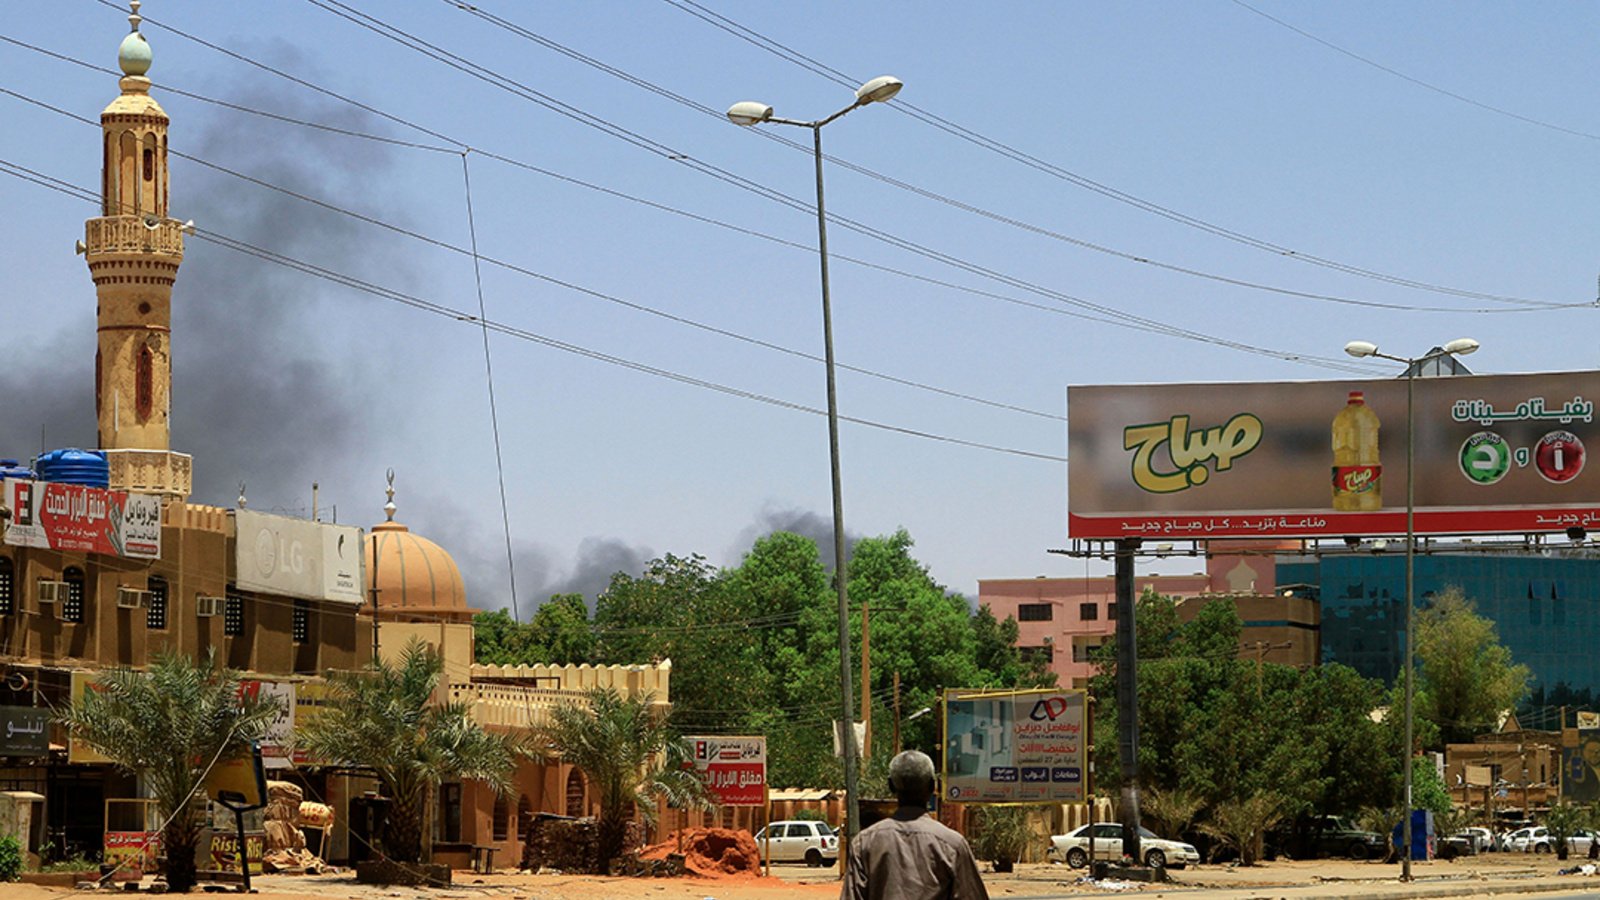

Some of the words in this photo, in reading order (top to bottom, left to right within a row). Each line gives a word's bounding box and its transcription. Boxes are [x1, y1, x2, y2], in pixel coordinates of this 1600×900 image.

[1453, 397, 1593, 425] بفيتامينات
[1123, 412, 1264, 494] صباح
[1344, 468, 1372, 491] صباح
[1121, 521, 1161, 533] جديد
[1164, 520, 1202, 533] صباح
[1279, 517, 1326, 529] مناعة
[1536, 513, 1579, 526] جديد
[280, 538, 303, 574] LG
